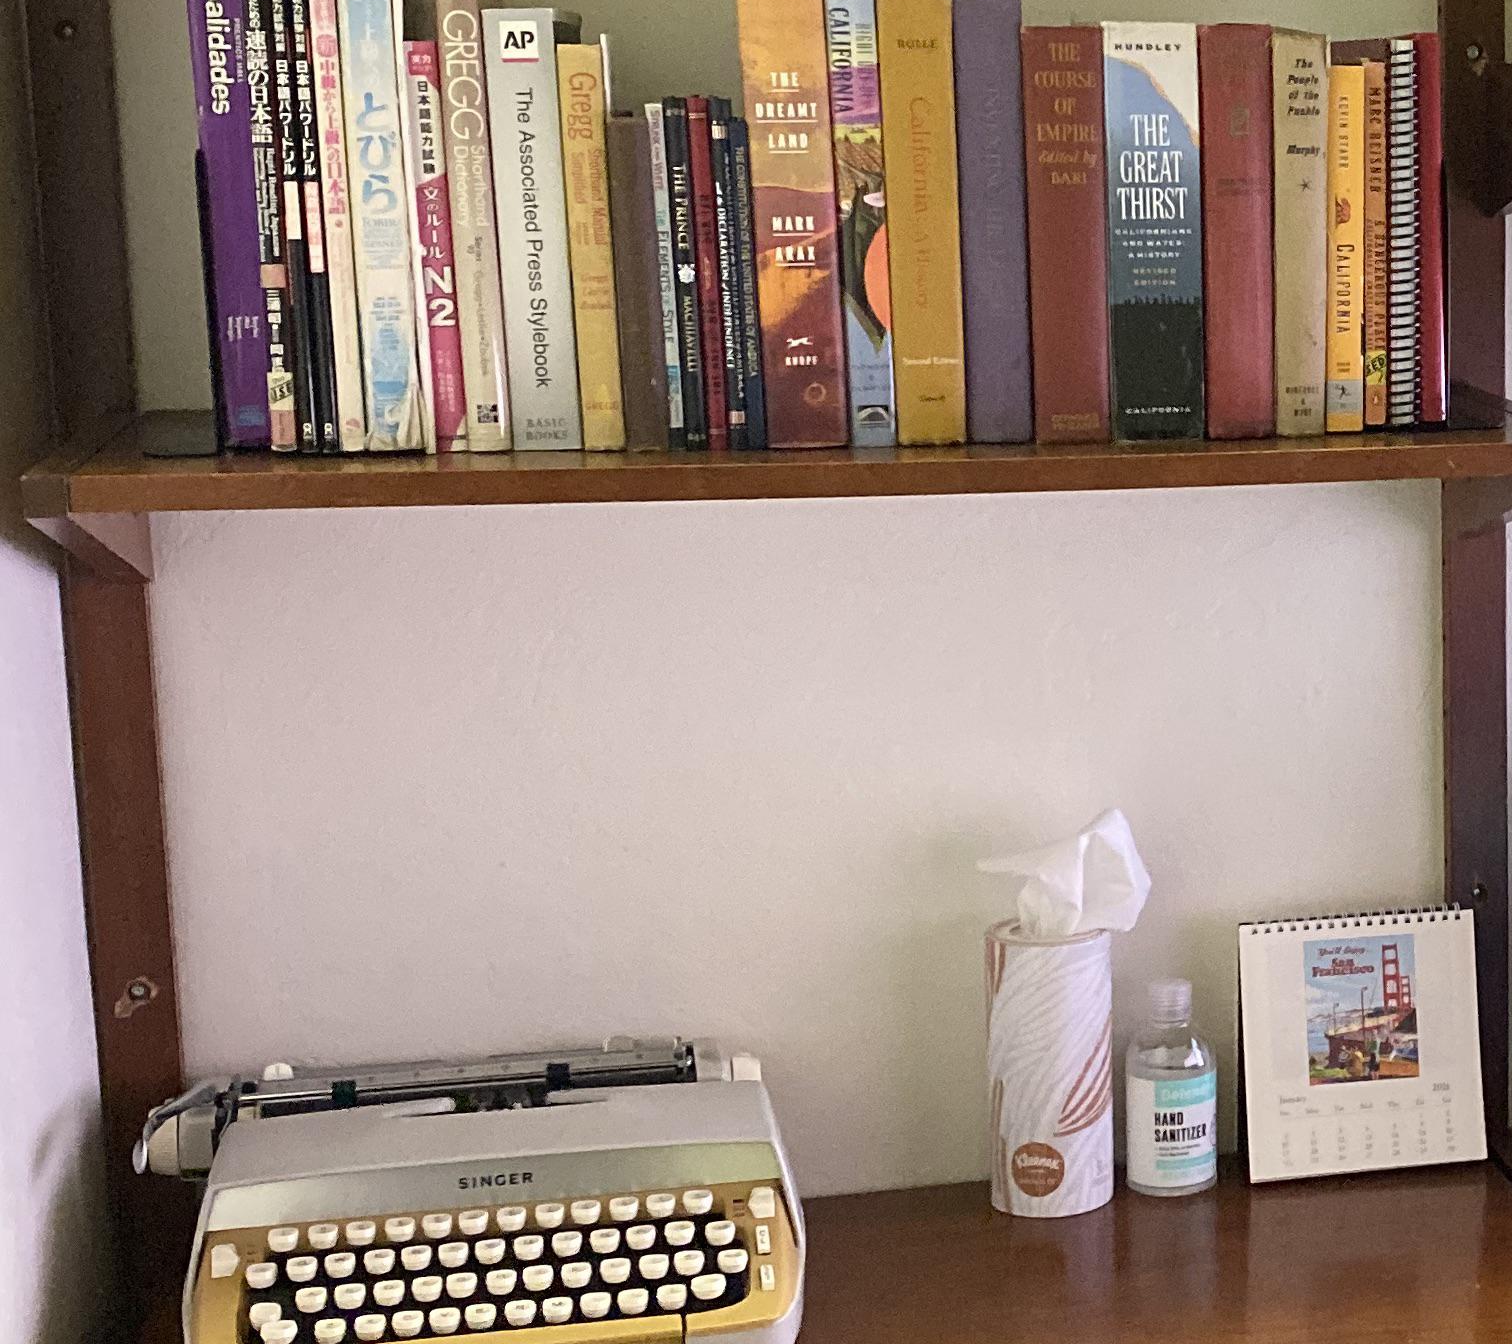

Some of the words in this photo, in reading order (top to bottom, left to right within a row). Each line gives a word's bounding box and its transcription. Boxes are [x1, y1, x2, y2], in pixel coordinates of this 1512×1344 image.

[503, 30, 535, 49] AP
[897, 38, 938, 49] ROLLE
[1048, 42, 1080, 62] THE
[1114, 42, 1182, 52] HUNDLEY
[442, 9, 483, 139] GREGG
[828, 7, 854, 113] CALIFORNIA
[1293, 58, 1313, 69] The
[770, 71, 799, 87] THE
[1034, 70, 1097, 89] COURSE
[1286, 74, 1320, 87] People
[515, 87, 534, 124] The
[567, 72, 598, 141] Gregg
[755, 102, 817, 118] DREAMT
[1054, 97, 1077, 115] OF
[1288, 90, 1300, 101] of
[1368, 87, 1382, 124] MARC
[1338, 96, 1349, 128] KEVIN
[768, 133, 809, 149] LAND
[1036, 122, 1096, 142] EMPIRE
[1129, 113, 1171, 147] THE
[735, 146, 745, 163] THE
[1286, 144, 1321, 158] Murphy
[1339, 135, 1349, 169] STARR
[1369, 132, 1382, 193] REISNER
[519, 129, 542, 233] Associated
[570, 152, 588, 205] Simplified
[588, 149, 605, 202] Shorthand
[672, 163, 688, 194] THE
[1119, 150, 1183, 184] GREAT
[453, 145, 471, 227] Dictionary
[470, 145, 489, 227] Shorthand
[735, 164, 749, 229] CONSTITUTION
[1116, 186, 1188, 221] THIRST
[674, 197, 690, 251] PRINCE
[772, 216, 815, 231] MARK
[1114, 227, 1193, 236] CALIFORNIANS
[716, 207, 731, 281] DECLARATION
[740, 244, 751, 260] THE
[775, 246, 816, 261] ARAX
[1122, 239, 1144, 248] AND
[1136, 251, 1181, 259] HISTORY
[525, 239, 546, 292] Press
[658, 230, 672, 293] ELEMENTS
[1374, 233, 1386, 307] DANGEROUS
[1335, 243, 1355, 334] CALIFORNIA
[744, 296, 756, 325] STATES
[662, 310, 675, 344] STYLE
[682, 295, 698, 372] MACHIAVELLI
[722, 291, 736, 368] INDEPENDENCE
[746, 327, 757, 337] OF
[528, 298, 552, 388] Stylebook
[747, 339, 761, 377] AMERICA
[526, 418, 568, 428] BASIC
[1124, 406, 1192, 415] CALIFORNIA
[525, 431, 568, 440] BOOKS
[1153, 1111, 1185, 1127] HAND
[1153, 1123, 1207, 1144] SANITIZER
[458, 1172, 534, 1189] SINGER
